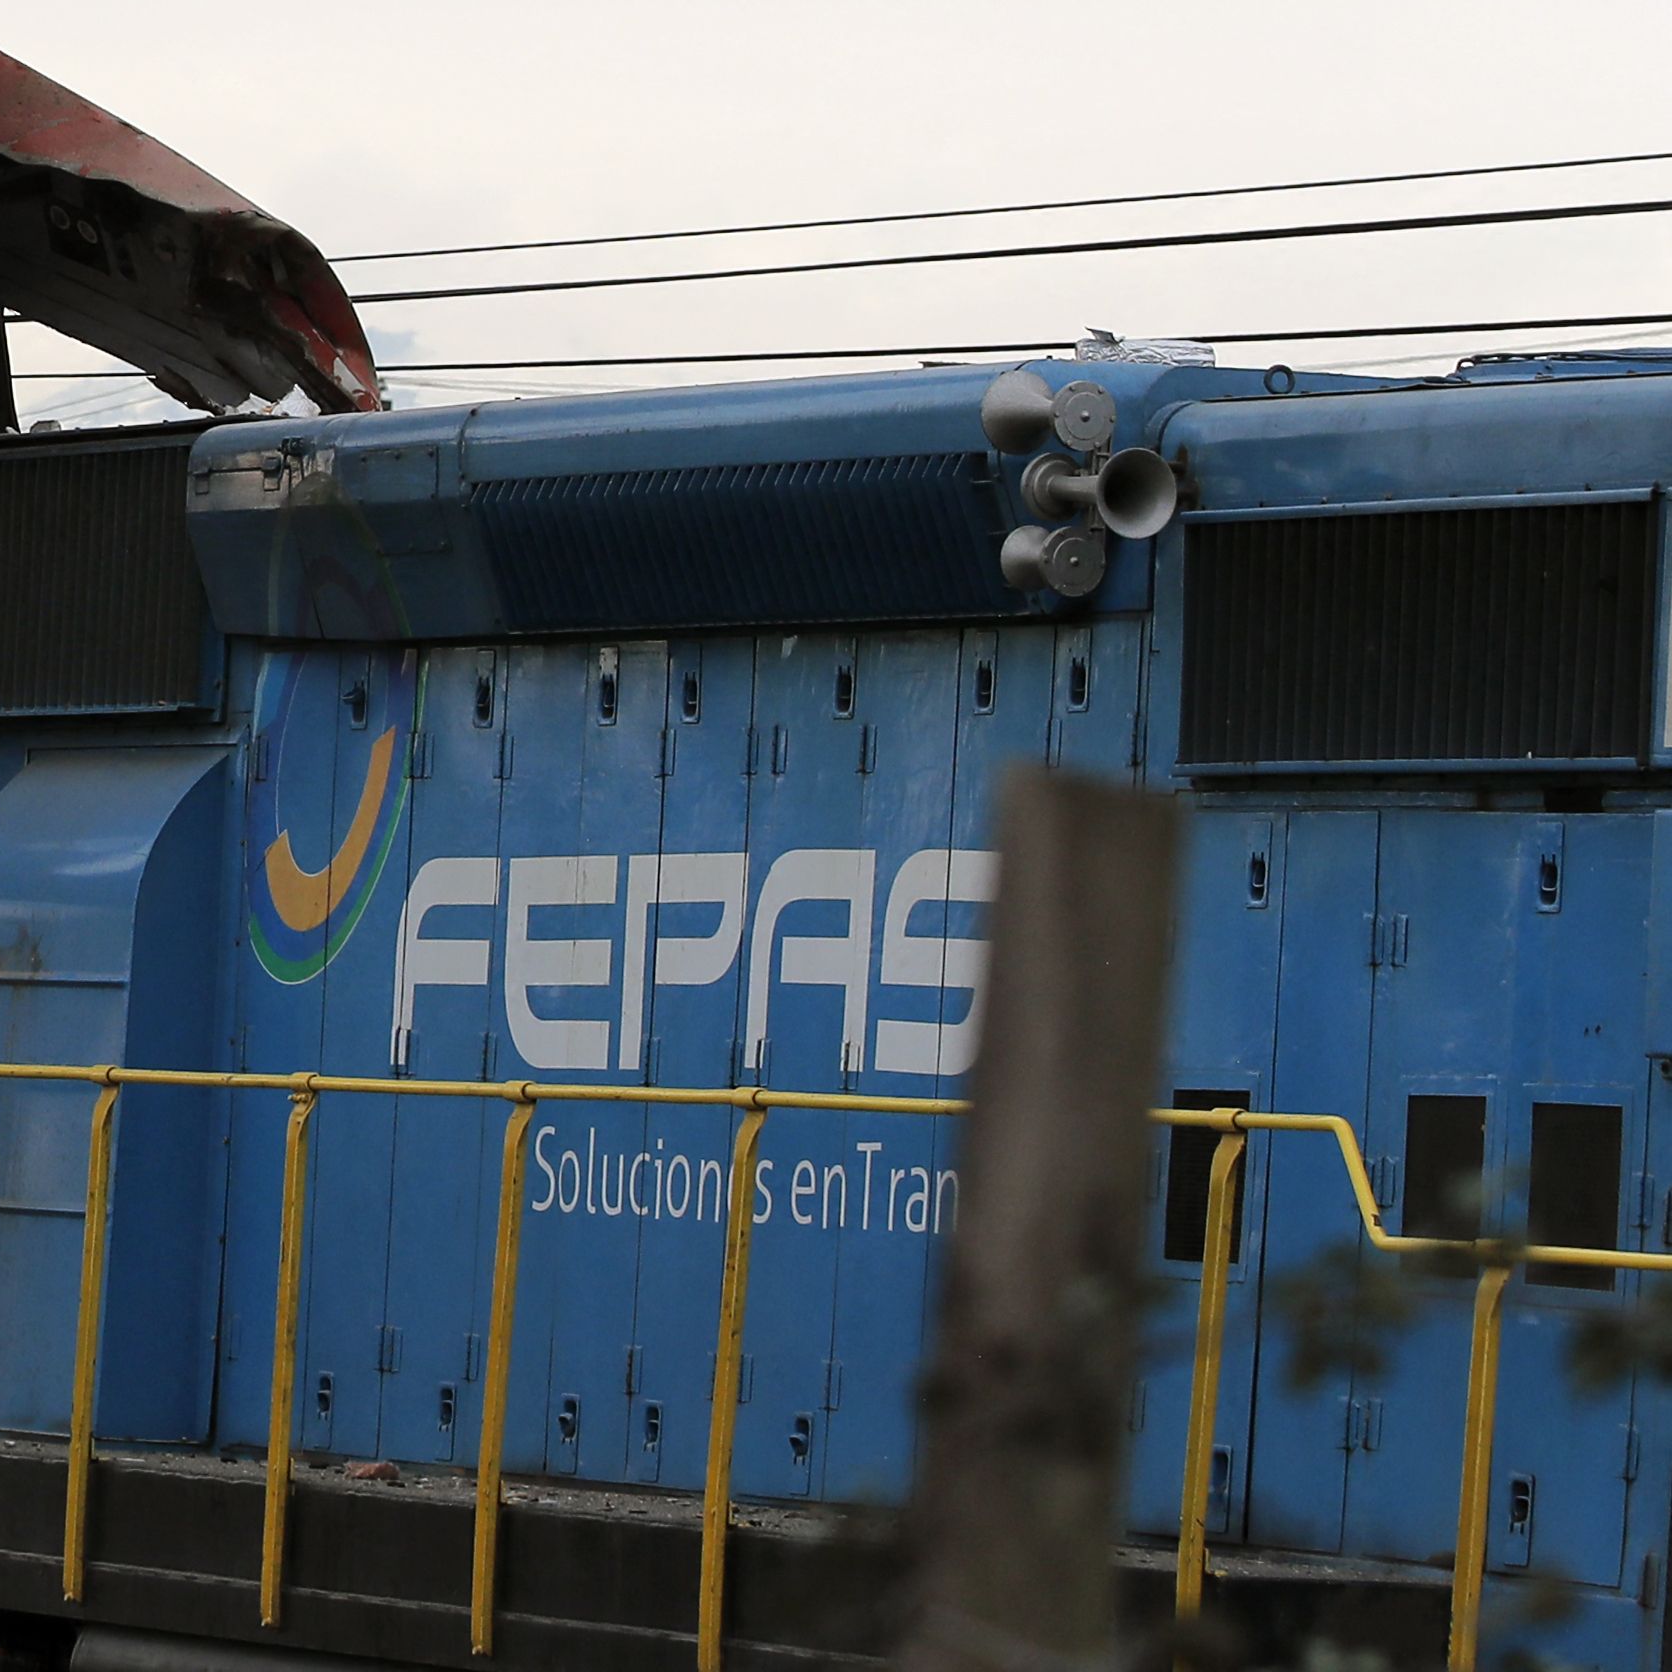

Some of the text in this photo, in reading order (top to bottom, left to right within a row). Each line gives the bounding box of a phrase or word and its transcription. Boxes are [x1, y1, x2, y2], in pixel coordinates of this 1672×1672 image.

[389, 847, 1001, 1077] FEPAS
[532, 1125, 959, 1235] Solucions en Tran
